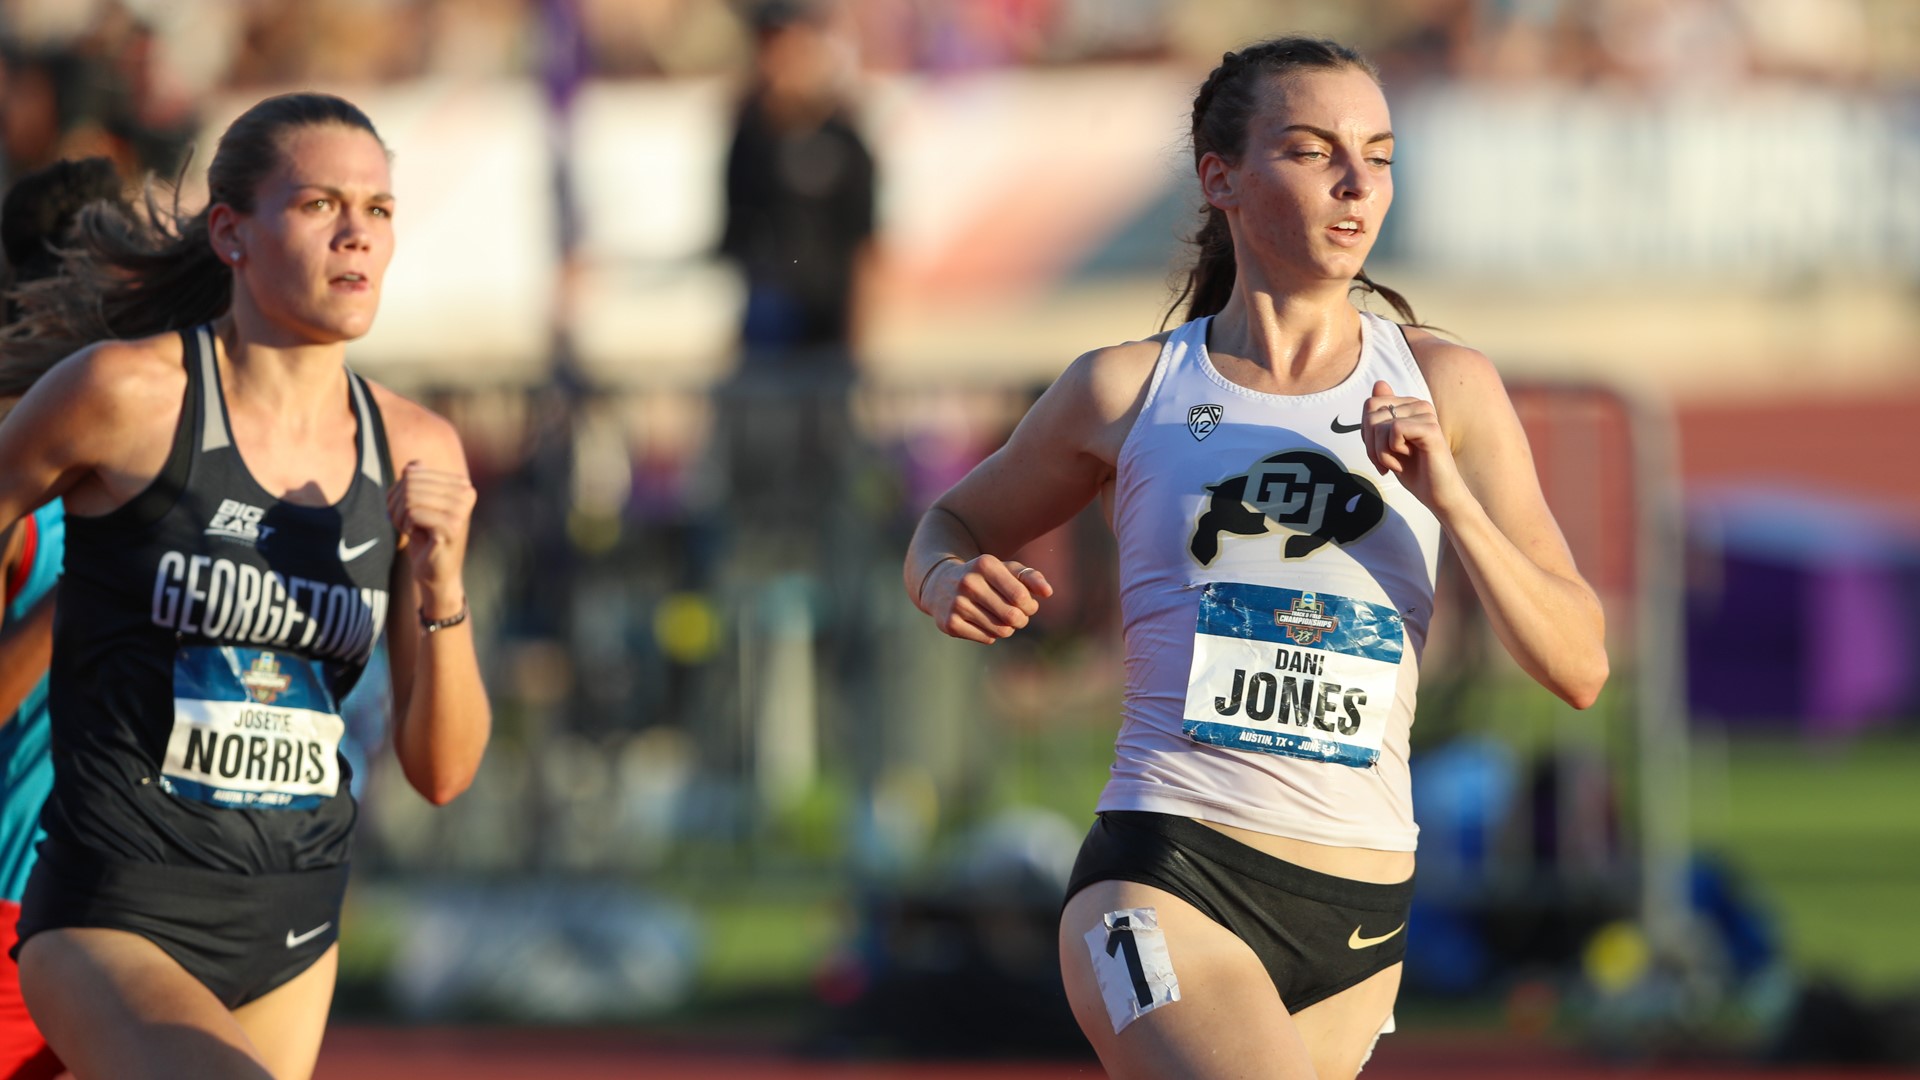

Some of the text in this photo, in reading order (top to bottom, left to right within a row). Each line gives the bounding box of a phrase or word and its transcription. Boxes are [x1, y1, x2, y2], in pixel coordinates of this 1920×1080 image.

[1190, 406, 1221, 427] PAC
[1194, 420, 1212, 434] 12
[218, 498, 265, 523] BIG
[1241, 462, 1335, 536] CU
[209, 513, 276, 540] EAST
[1279, 614, 1333, 628] CHAMPIONSHIPS
[1275, 648, 1326, 676] DANI
[1214, 669, 1368, 736] JONES
[1239, 731, 1273, 746] AUSTIN,
[1275, 736, 1288, 747] TX
[1298, 740, 1321, 753] JUNE
[183, 728, 325, 784] NORRIS
[1106, 916, 1154, 1008] 1
